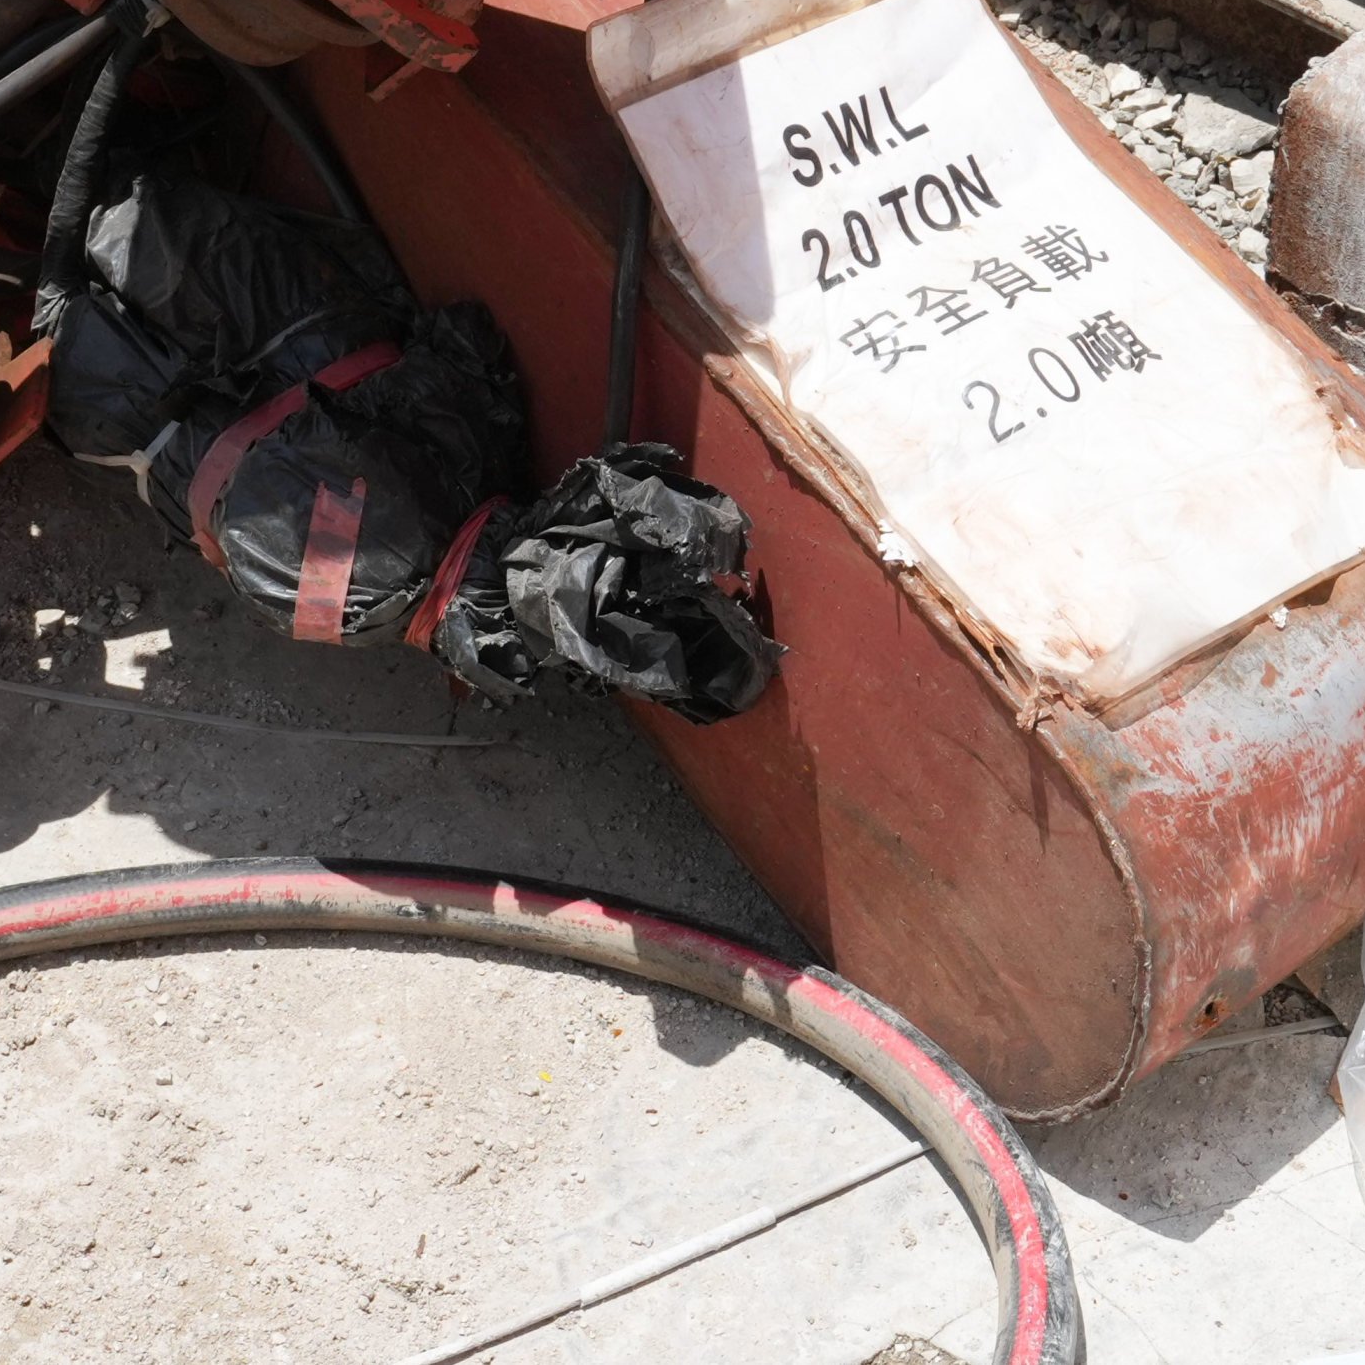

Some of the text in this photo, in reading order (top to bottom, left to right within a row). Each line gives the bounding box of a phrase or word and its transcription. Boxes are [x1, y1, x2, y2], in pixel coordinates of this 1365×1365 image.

[782, 85, 930, 188] S.W.L
[801, 153, 1003, 293] 2.0 TON
[838, 224, 1110, 374] 安全負載
